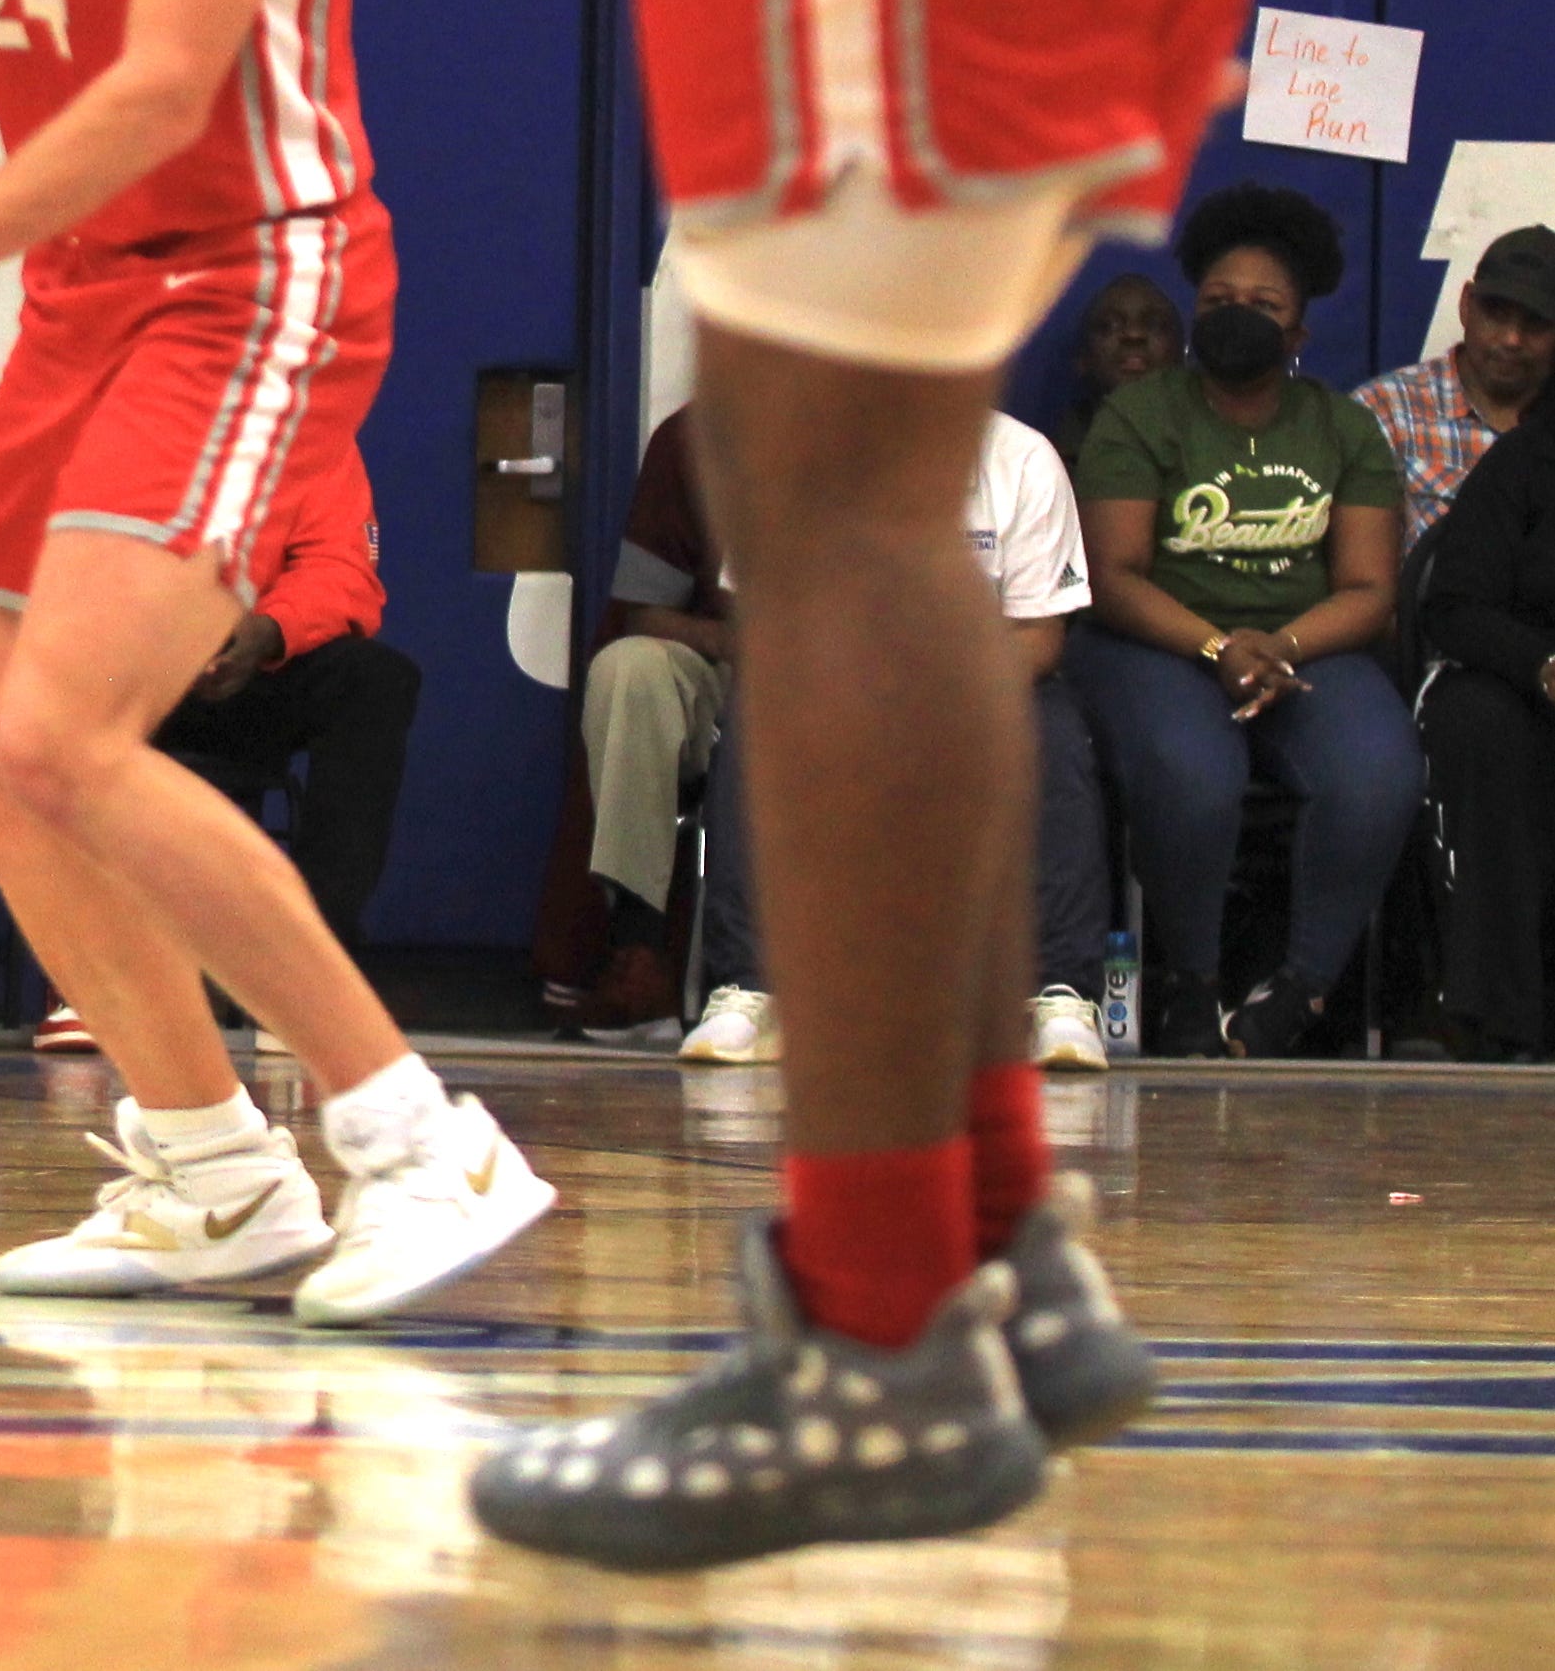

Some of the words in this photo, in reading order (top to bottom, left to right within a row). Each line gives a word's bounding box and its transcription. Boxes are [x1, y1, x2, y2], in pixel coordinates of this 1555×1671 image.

[1267, 17, 1330, 64] Line
[1342, 33, 1370, 67] to
[1306, 101, 1369, 144] Run
